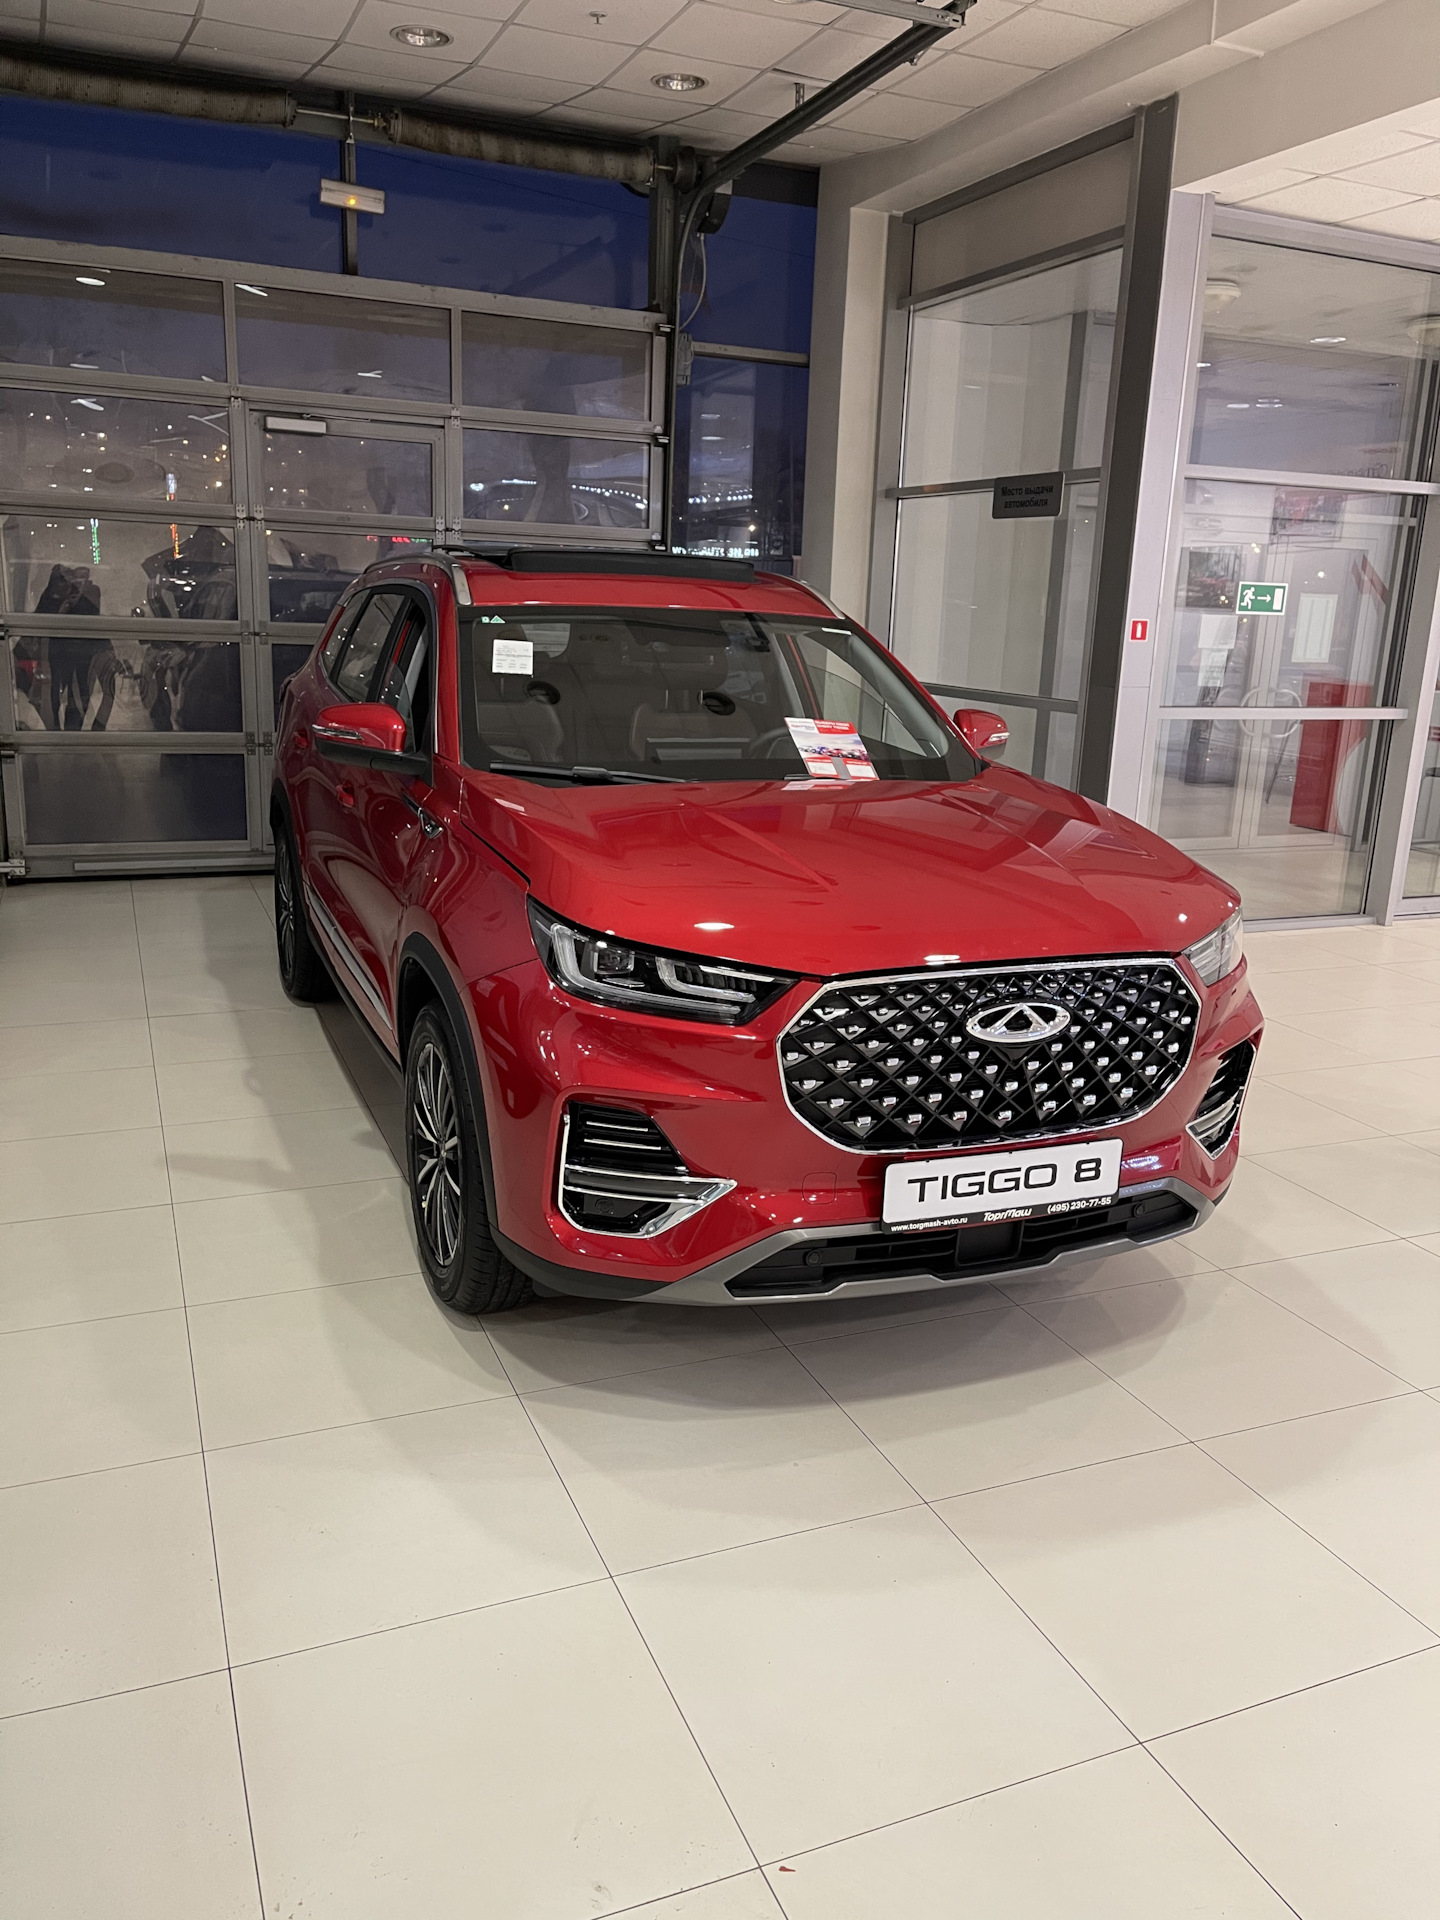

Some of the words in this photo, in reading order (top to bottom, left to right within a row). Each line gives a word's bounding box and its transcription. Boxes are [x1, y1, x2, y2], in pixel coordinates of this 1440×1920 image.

[1001, 486, 1023, 497] Место
[1024, 485, 1054, 495] выдачи
[1004, 497, 1048, 509] автомобиля
[907, 1163, 1058, 1203] TIGGO
[1074, 1157, 1102, 1183] 8
[1047, 1201, 1070, 1214] (495)
[1070, 1197, 1112, 1210] 230-77-55
[891, 1217, 968, 1232] www.torgmash-avto.ru
